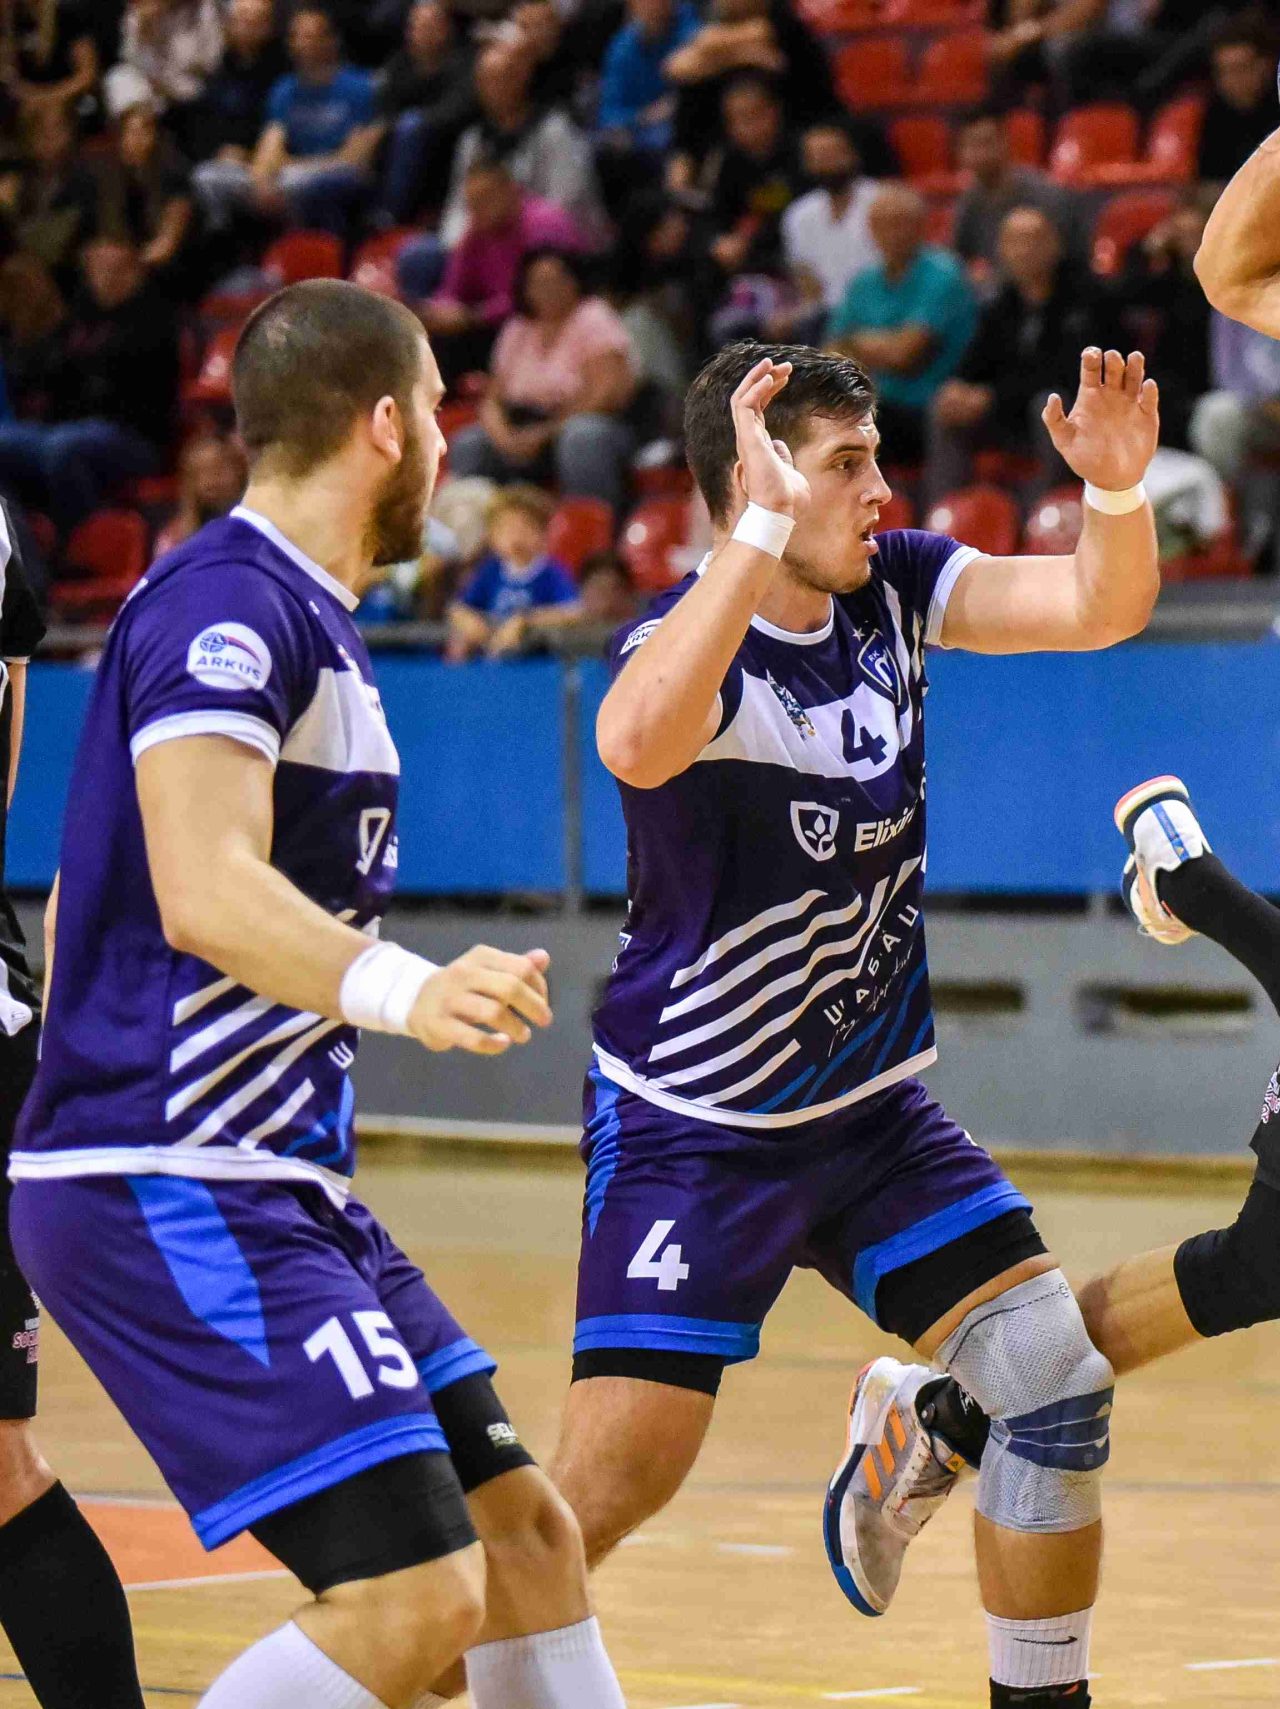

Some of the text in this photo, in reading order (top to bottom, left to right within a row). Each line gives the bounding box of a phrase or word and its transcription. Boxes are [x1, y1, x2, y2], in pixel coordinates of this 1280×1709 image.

[196, 655, 262, 681] ARKUS
[841, 708, 888, 766] 4
[626, 1220, 690, 1291] 4
[302, 1311, 419, 1400] 15
